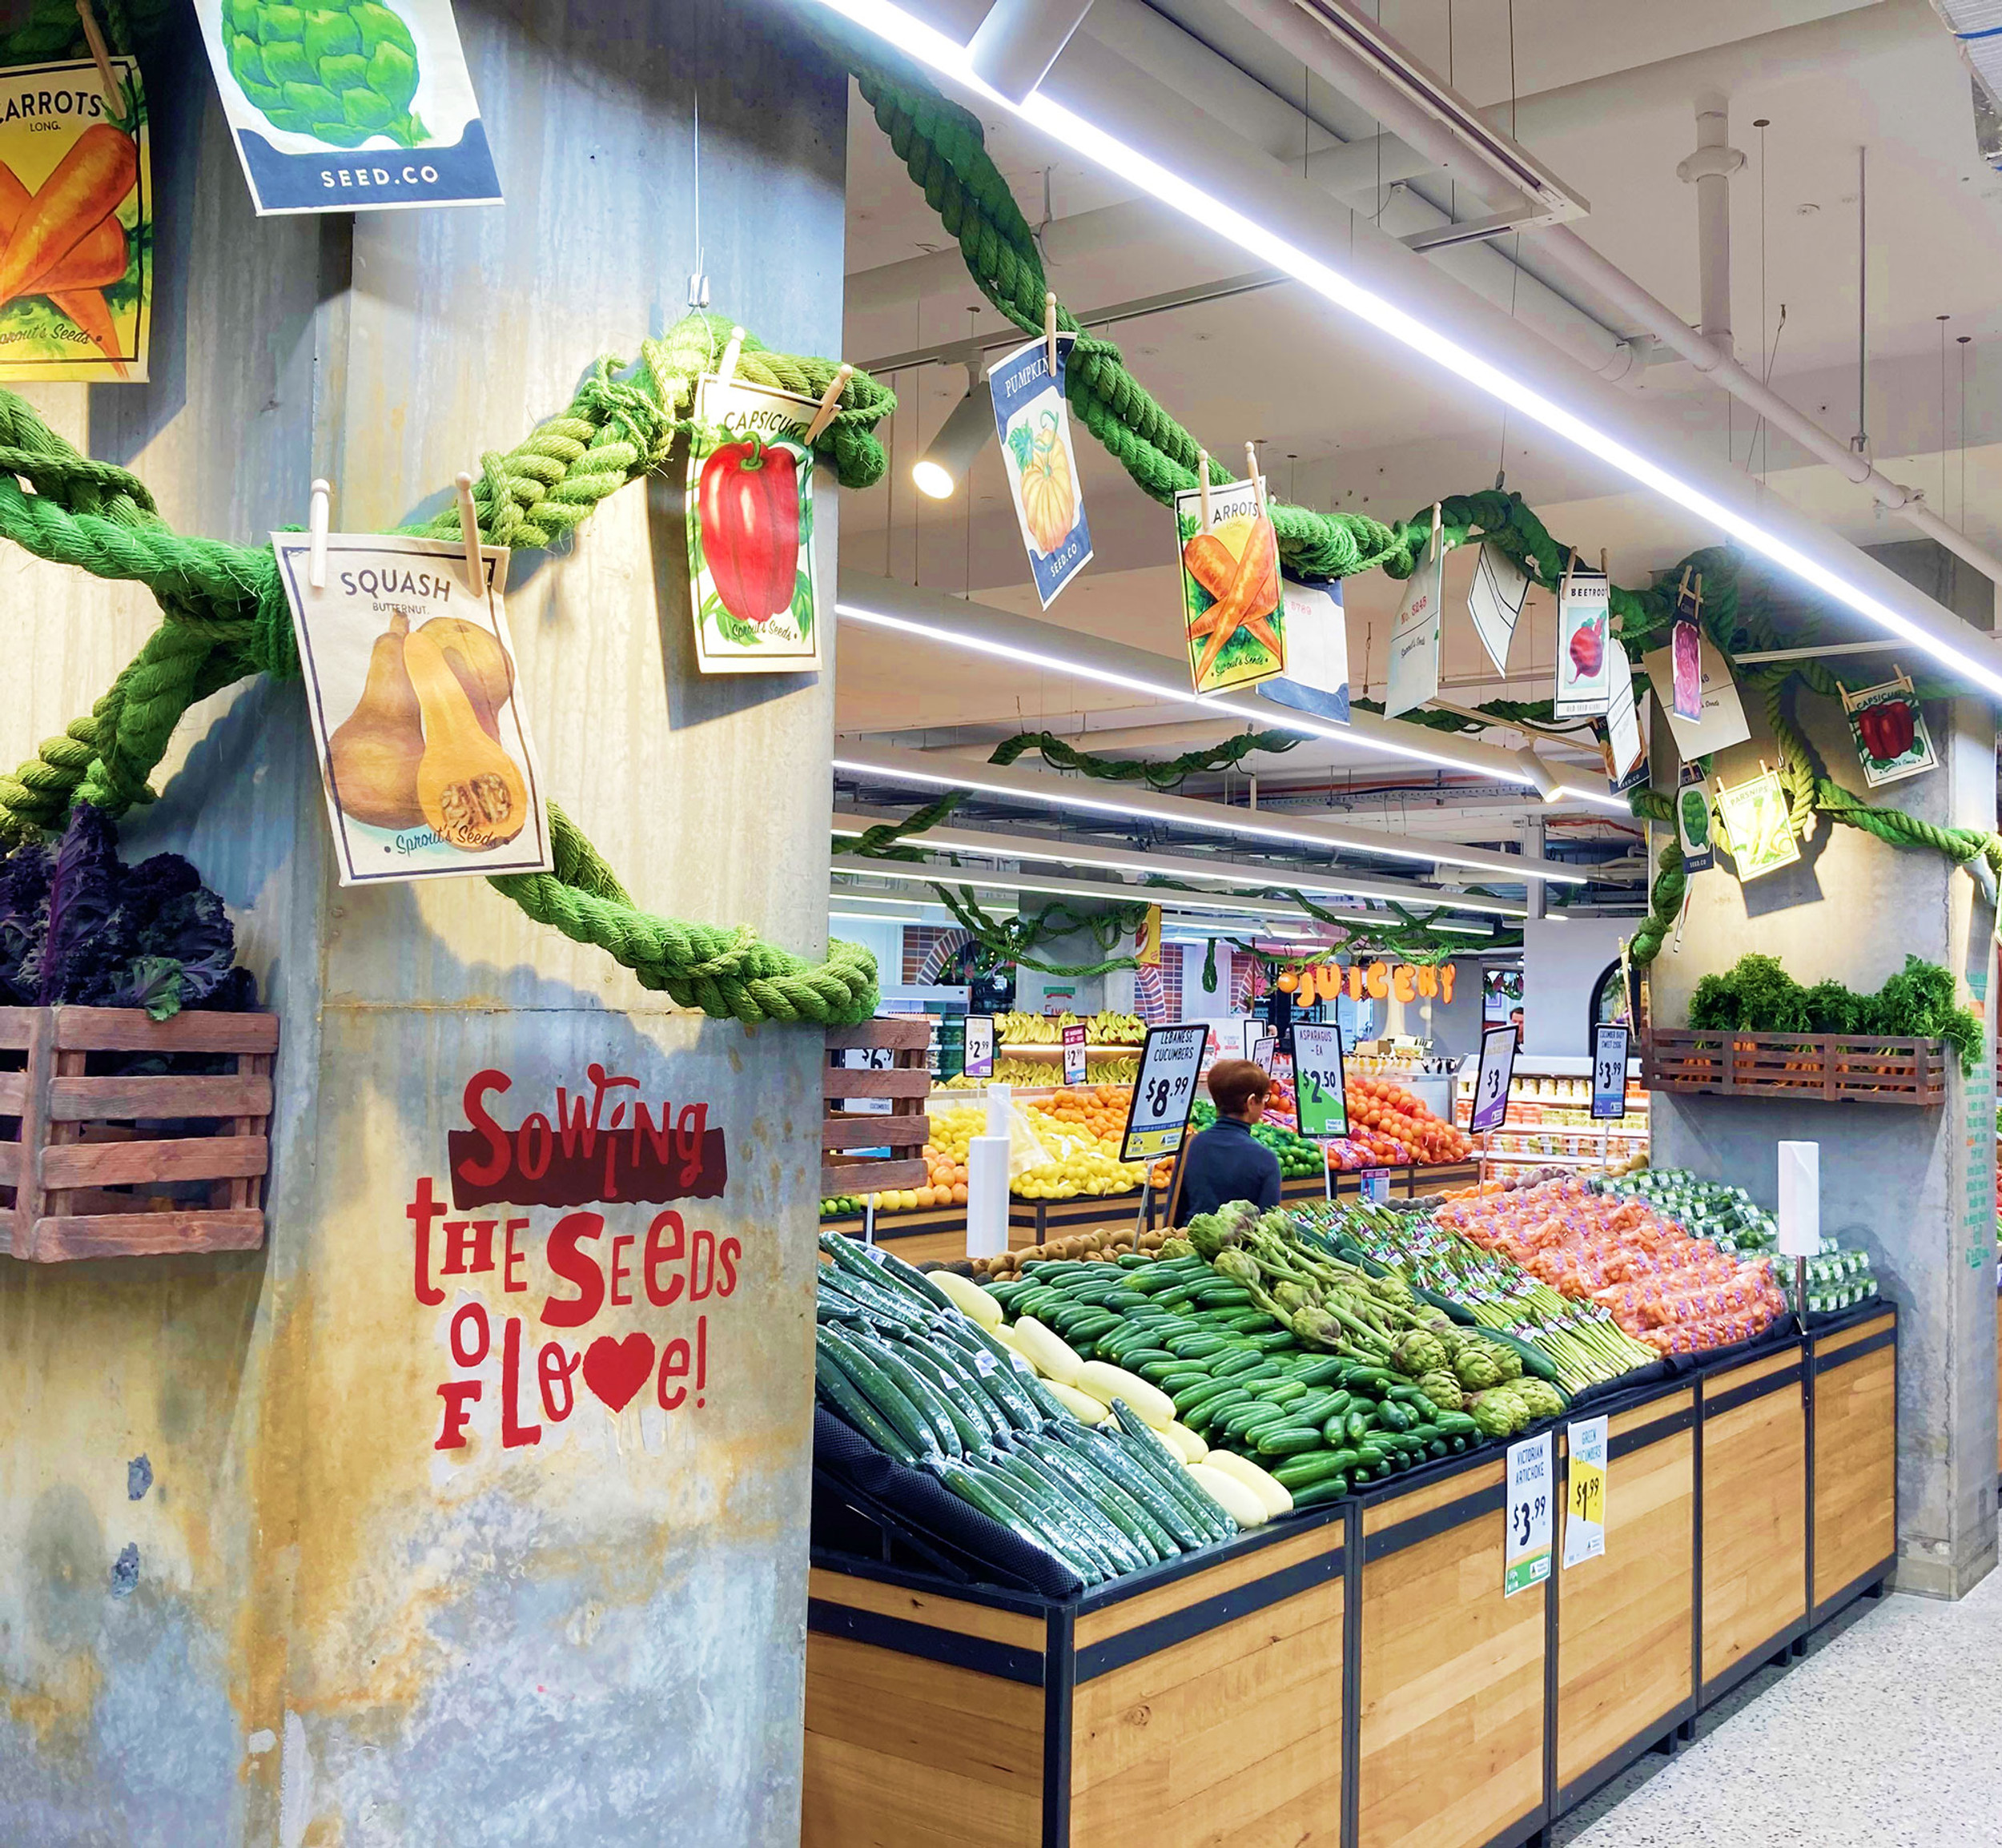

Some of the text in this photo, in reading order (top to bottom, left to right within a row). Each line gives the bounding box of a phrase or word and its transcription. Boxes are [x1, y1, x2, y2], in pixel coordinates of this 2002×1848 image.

[0, 90, 102, 123] ARROTS
[321, 165, 439, 188] SEED.CO
[50, 323, 90, 344] Seeds
[724, 410, 802, 440] CAPSICUM
[1212, 501, 1259, 524] ARROTS
[1050, 543, 1077, 577] SEED.CO
[340, 568, 451, 602] SQUASH
[769, 619, 792, 641] Seeds
[1730, 785, 1770, 806] PARSNIPS
[395, 824, 500, 858] Sprout's Seeds
[1296, 959, 1457, 1008] JUICERY
[969, 1039, 990, 1058] $2.99
[1160, 1030, 1194, 1045] LEBANESE
[1300, 1030, 1333, 1043] ASPARAGUS
[1067, 1048, 1083, 1067] $2.99
[1154, 1047, 1195, 1063] CUCUMBERS
[1303, 1068, 1336, 1103] $2.50
[1487, 1068, 1500, 1099] $3
[1598, 1061, 1622, 1090] $3.99
[1145, 1076, 1189, 1118] $8.99
[1517, 1444, 1544, 1465] VICTORIAN
[1515, 1461, 1545, 1486] ARTICHOKE
[1576, 1476, 1600, 1521] $1.99
[1513, 1495, 1546, 1546] $3.99
